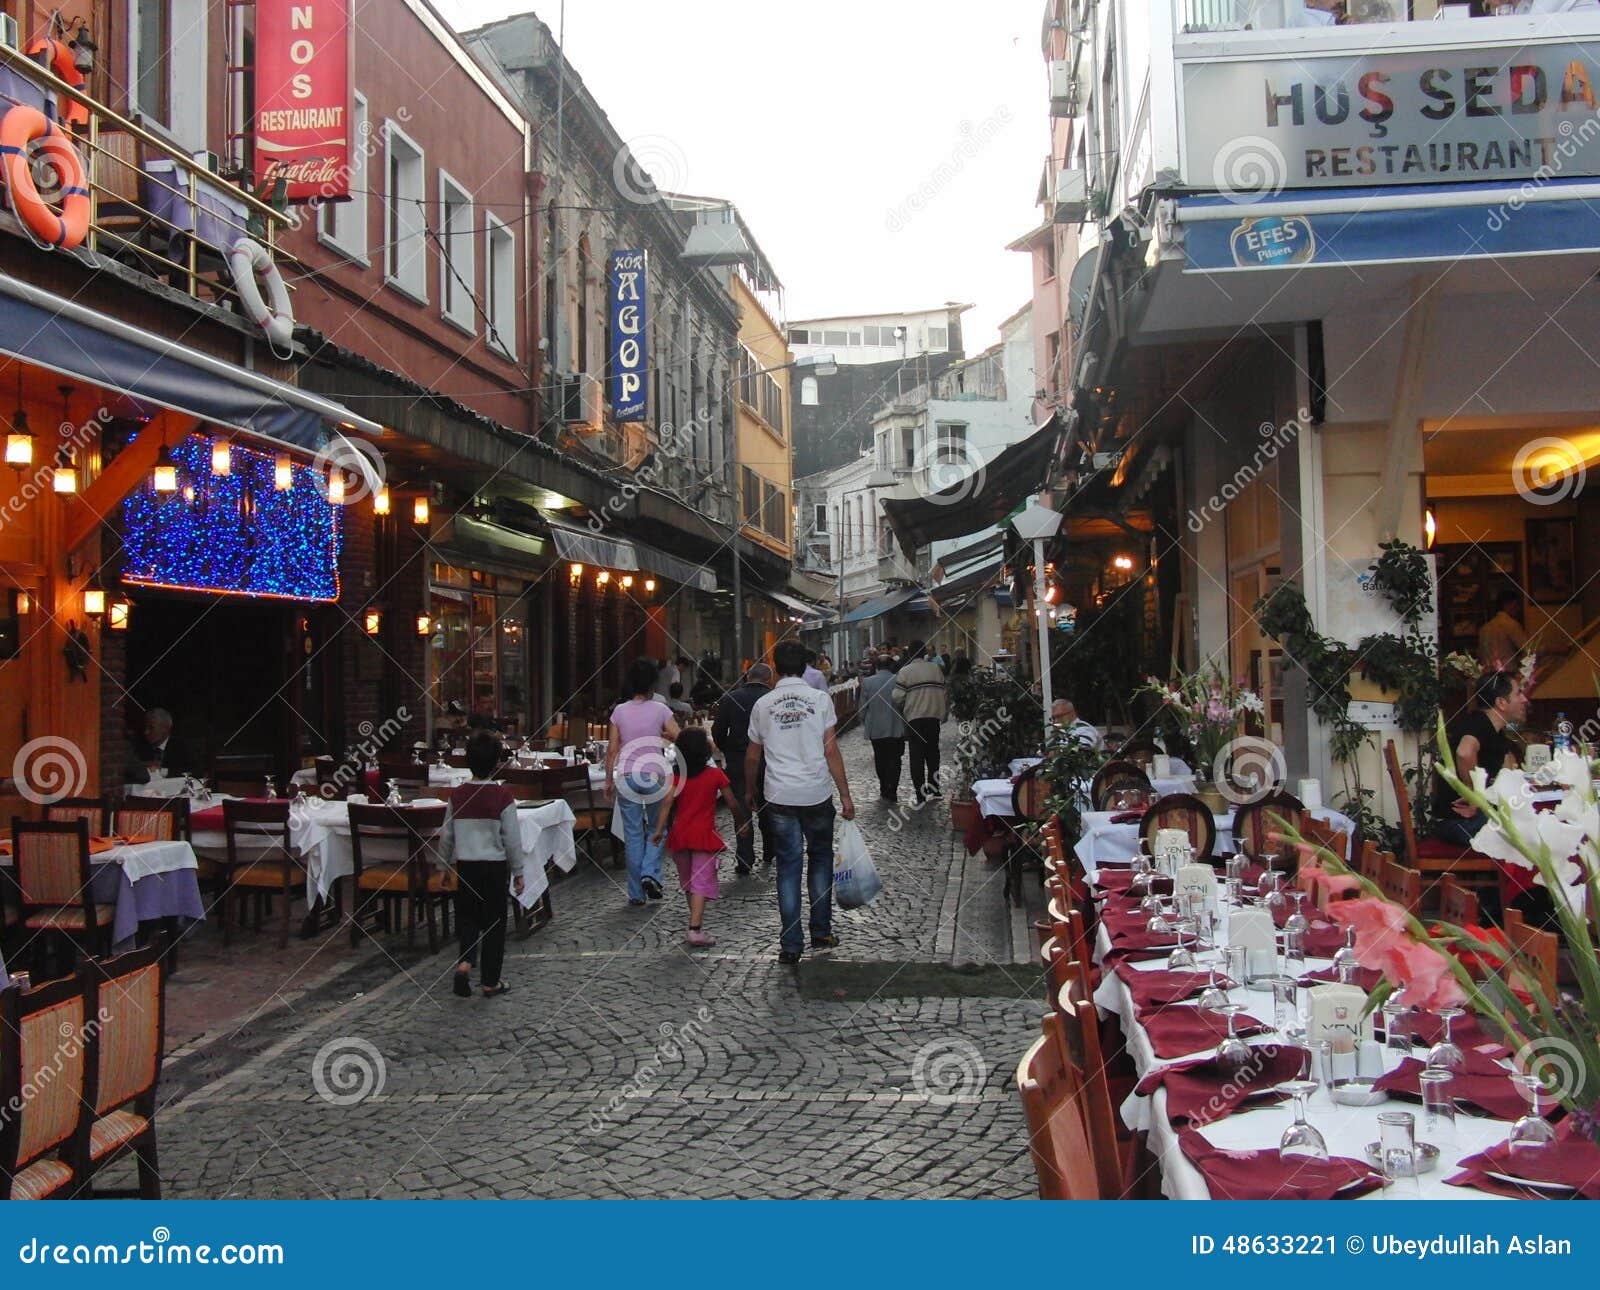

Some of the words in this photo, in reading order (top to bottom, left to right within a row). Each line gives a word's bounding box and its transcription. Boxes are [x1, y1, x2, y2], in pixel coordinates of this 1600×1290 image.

[1265, 71, 1394, 138] HUŞ
[1419, 59, 1597, 120] SEDA
[261, 107, 344, 132] RESTAURANT
[1304, 137, 1556, 178] RESTAURANT
[1245, 221, 1297, 250] EFES
[1257, 246, 1292, 261] Pilsen
[617, 272, 641, 402] AGOP
